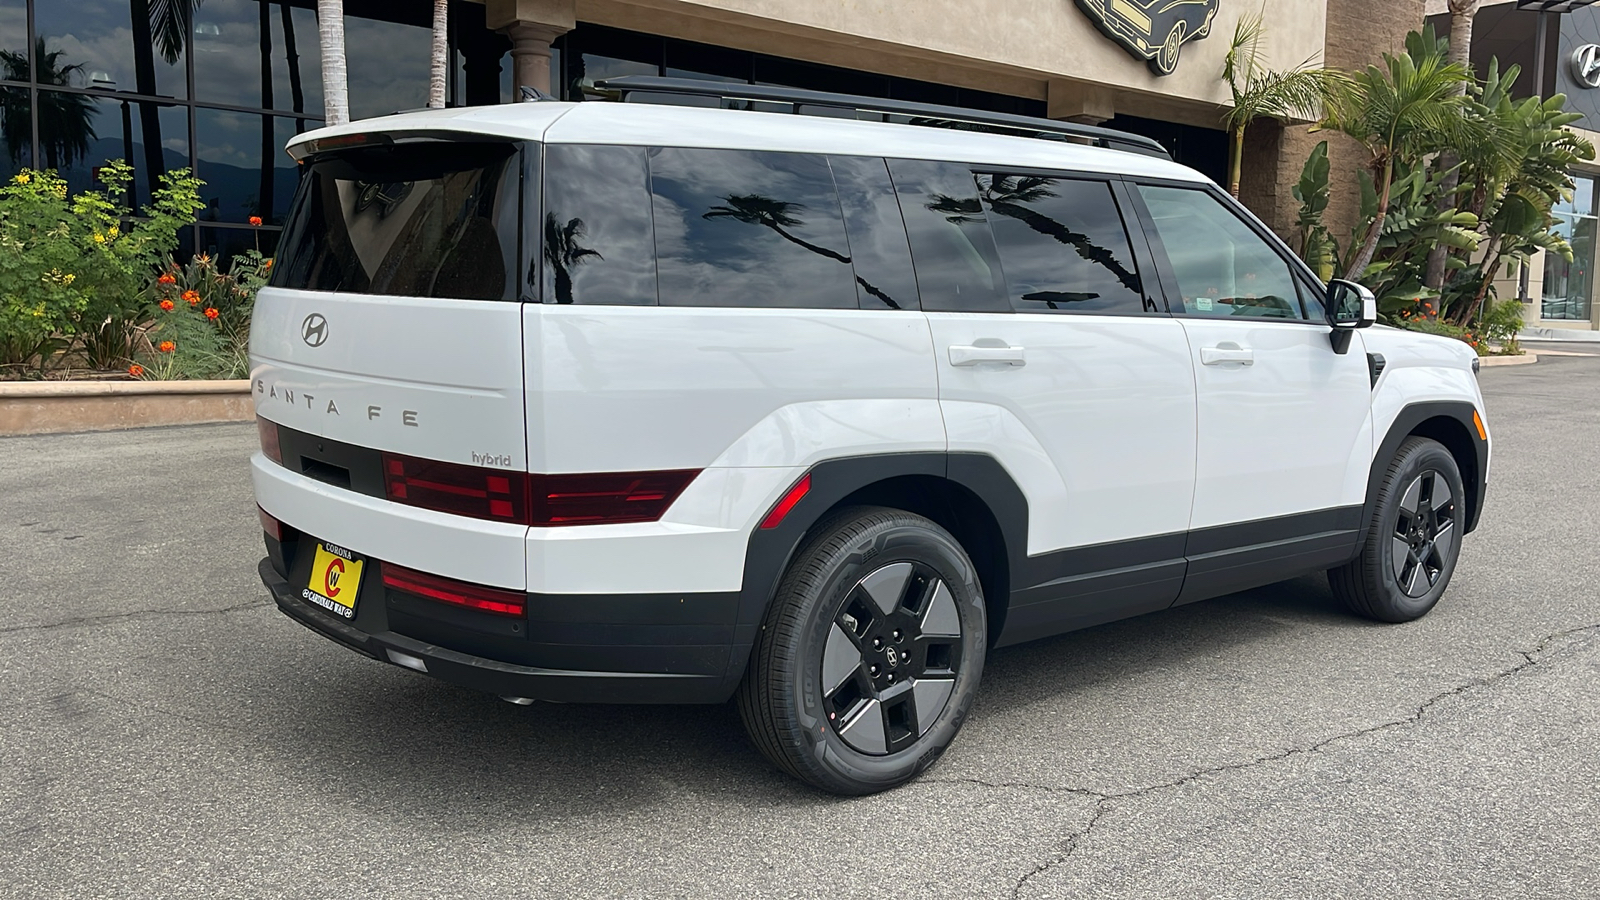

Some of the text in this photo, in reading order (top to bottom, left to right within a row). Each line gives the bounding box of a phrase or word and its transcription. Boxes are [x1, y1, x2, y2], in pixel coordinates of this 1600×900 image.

[257, 380, 419, 427] SANTA FE
[471, 450, 512, 467] hybrid
[325, 542, 352, 560] CORONA
[333, 602, 346, 616] WAY
